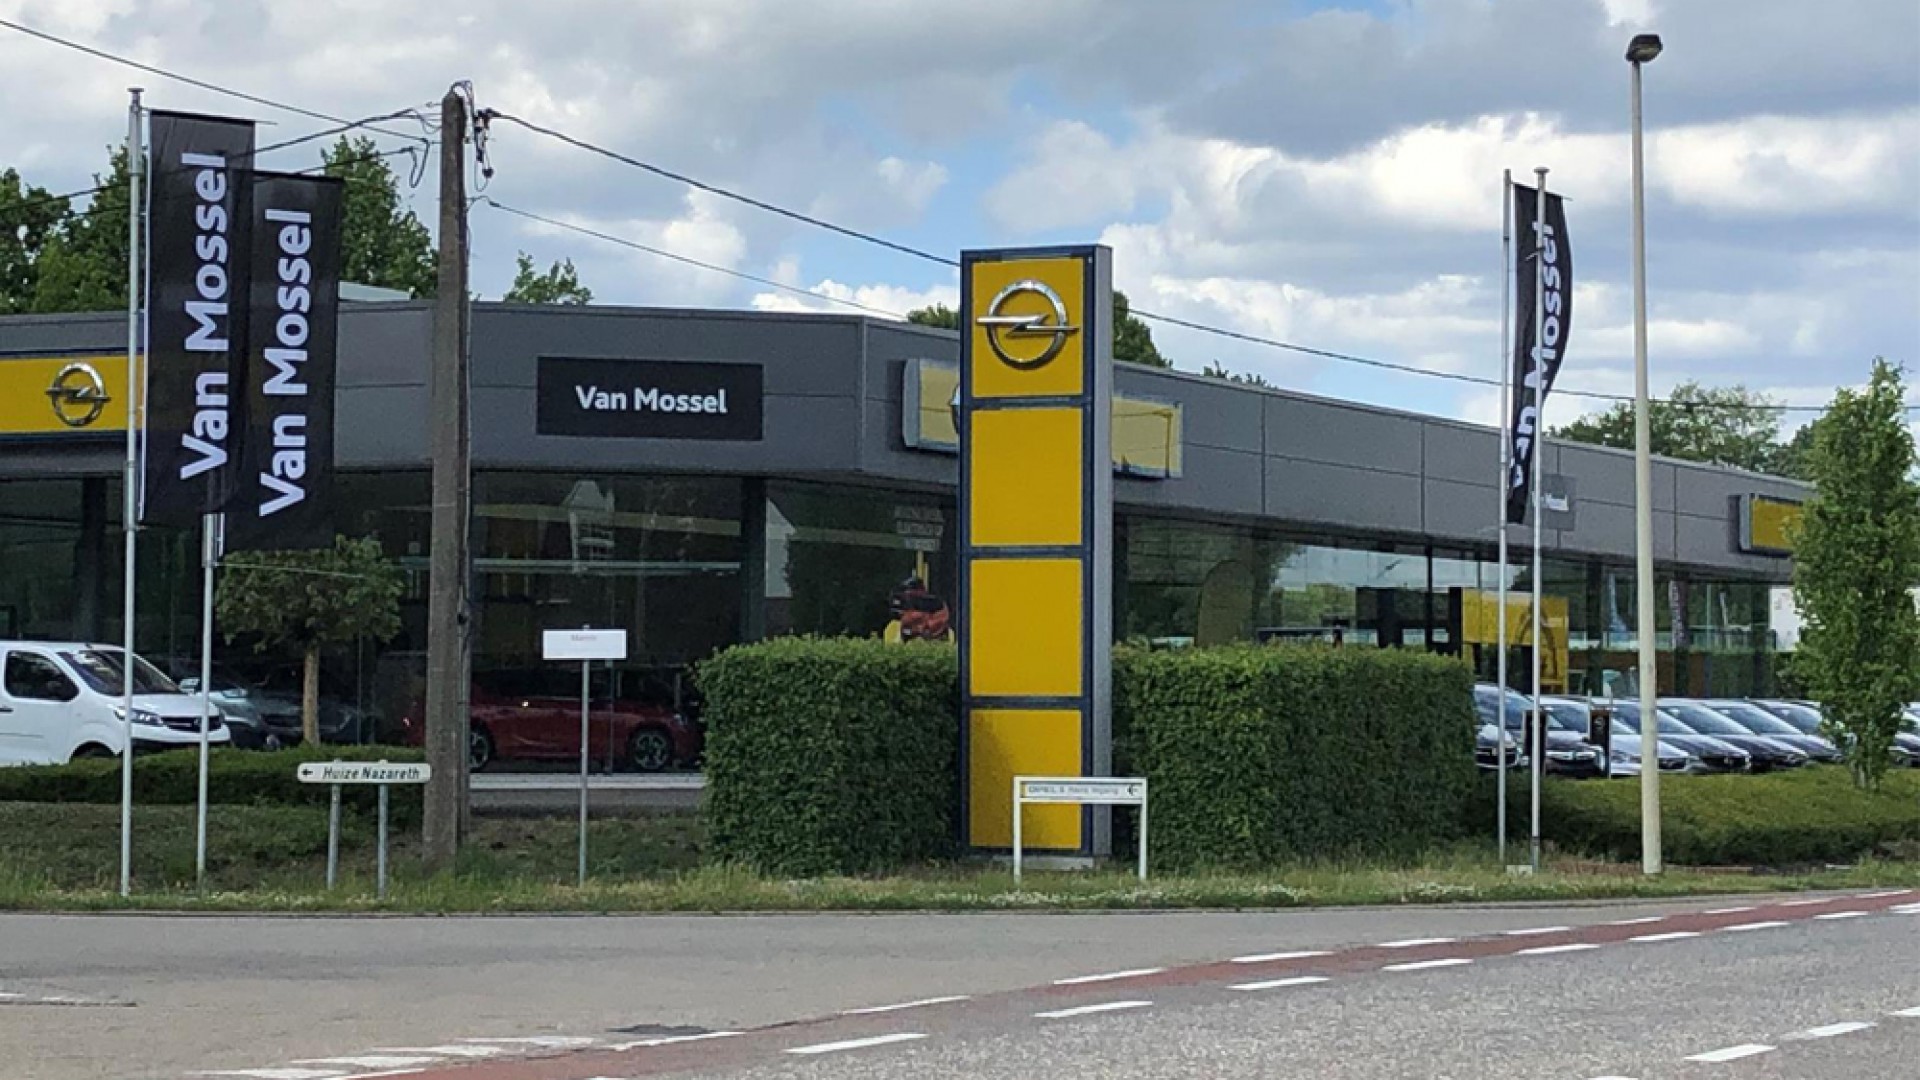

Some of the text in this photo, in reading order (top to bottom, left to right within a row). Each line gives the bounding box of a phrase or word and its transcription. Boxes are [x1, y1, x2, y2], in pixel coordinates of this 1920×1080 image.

[180, 152, 229, 479] Van Mossel
[259, 208, 311, 517] Van Mossel
[575, 385, 728, 413] Van Mossel
[322, 766, 421, 780] Huize Nazareth
